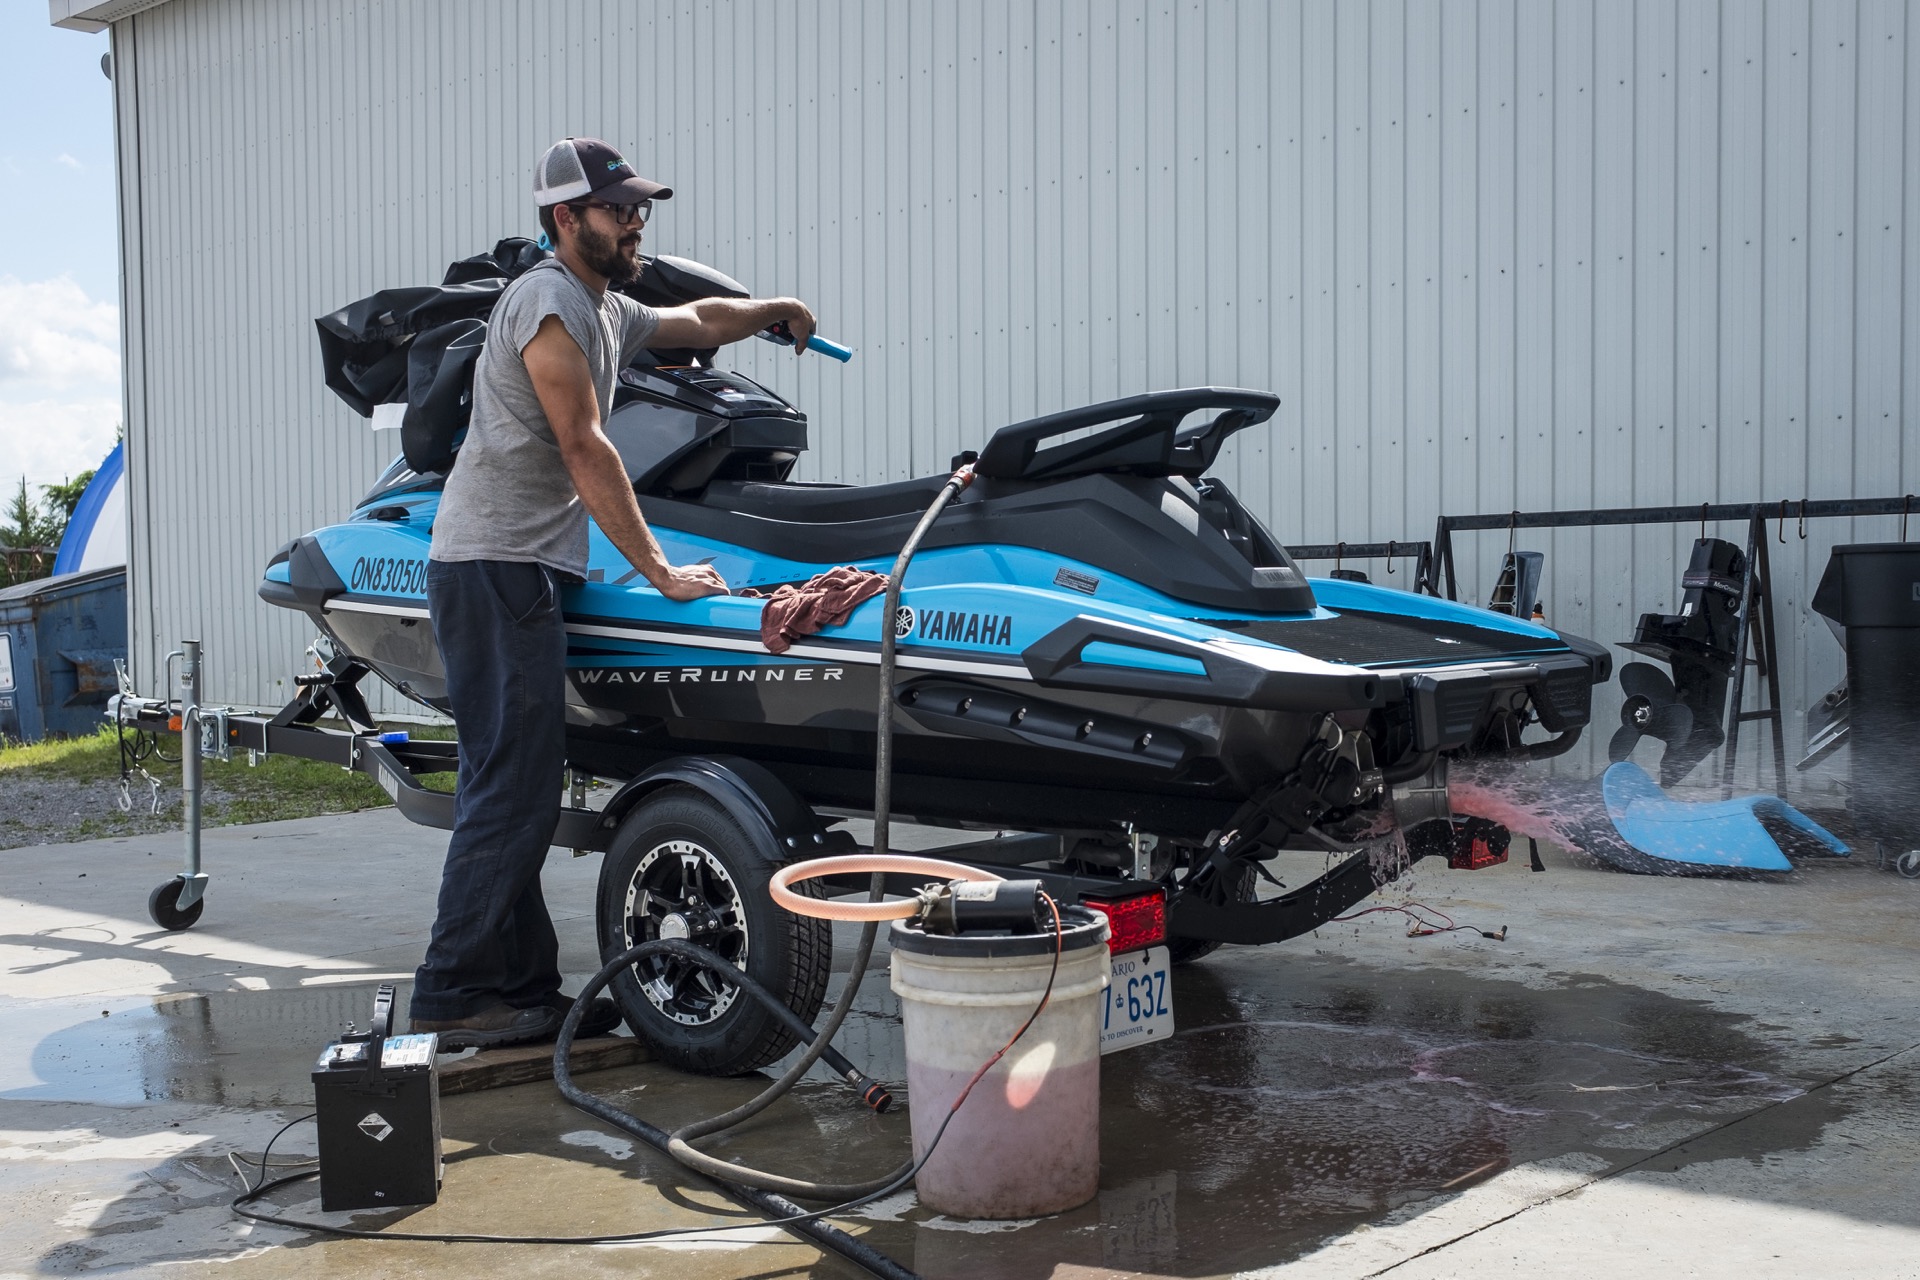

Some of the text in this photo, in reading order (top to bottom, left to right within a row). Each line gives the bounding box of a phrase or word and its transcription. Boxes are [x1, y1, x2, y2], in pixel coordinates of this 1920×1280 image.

[919, 609, 1012, 645] YAMAHA
[1128, 971, 1167, 1021] 63Z
[1107, 1033, 1116, 1041] TO
[1116, 1026, 1143, 1038] DISCOVER
